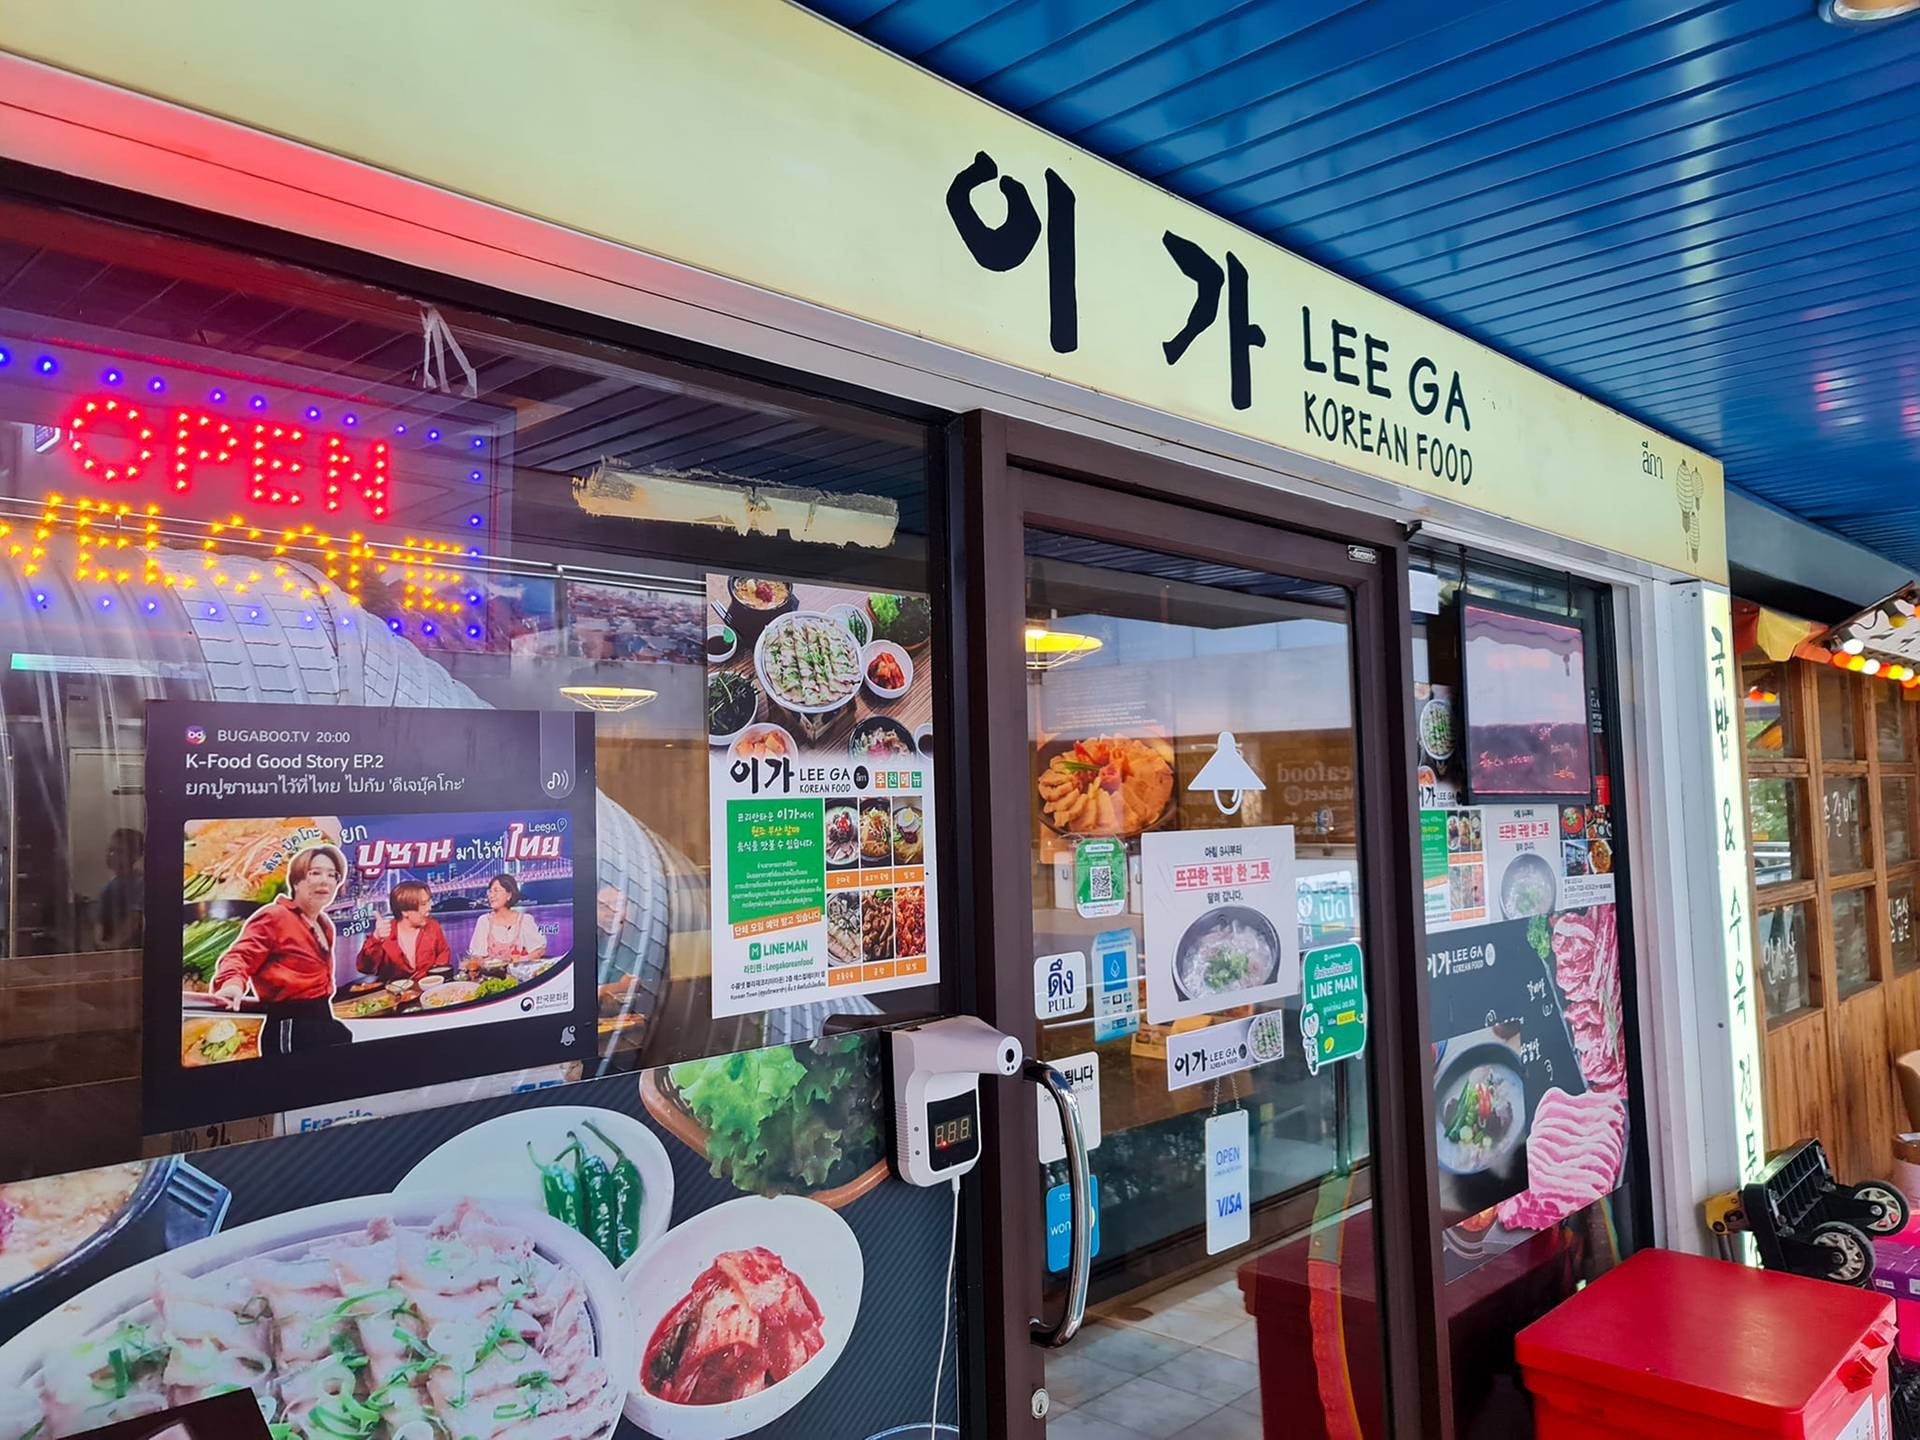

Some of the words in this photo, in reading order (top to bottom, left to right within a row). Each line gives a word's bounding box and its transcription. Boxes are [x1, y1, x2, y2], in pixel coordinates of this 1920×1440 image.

[945, 150, 1078, 354] 이
[1161, 229, 1266, 411] 가
[1302, 305, 1392, 399] LEE
[1409, 355, 1471, 433] GA
[1303, 389, 1409, 468] KOREAN
[1416, 433, 1473, 487] FOOD
[70, 396, 389, 518] OPEN
[217, 729, 310, 743] BUGABOO.TV
[316, 731, 351, 743] 20:00
[185, 753, 251, 769] K-Food
[256, 754, 302, 769] Good
[306, 754, 349, 773] Story
[353, 755, 384, 769] EP.2
[729, 756, 795, 794] 이가
[799, 768, 824, 782] LEE
[829, 767, 851, 781] GA
[185, 774, 341, 799] ยกปูซานมาไว้ที่ไทย
[345, 774, 385, 794] ไปกับ
[799, 783, 829, 794] KOREAN
[831, 783, 851, 793] FOOD
[340, 825, 368, 844] ยก
[528, 822, 557, 833] Leega
[357, 838, 453, 877] ปูซาน
[507, 822, 561, 859] ไทย
[1175, 866, 1209, 887] 뜨끈한
[1212, 864, 1233, 884] 국밥
[1236, 863, 1248, 882] 한
[763, 942, 785, 956] LINE
[786, 939, 808, 954] MAN
[1452, 947, 1469, 962] LEE
[1470, 944, 1484, 959] GA
[1047, 958, 1074, 998] ดึง
[1310, 980, 1333, 1000] LINE
[1335, 975, 1358, 993] MAN
[1048, 996, 1075, 1013] PULL
[1174, 1048, 1208, 1077] 이가
[1209, 1050, 1223, 1062] LEE
[1225, 1047, 1236, 1058] GA
[1064, 1064, 1094, 1086] 됩니다
[1215, 1146, 1240, 1166] OPEN
[1216, 1191, 1242, 1217] VISA
[1050, 1220, 1071, 1237] won
